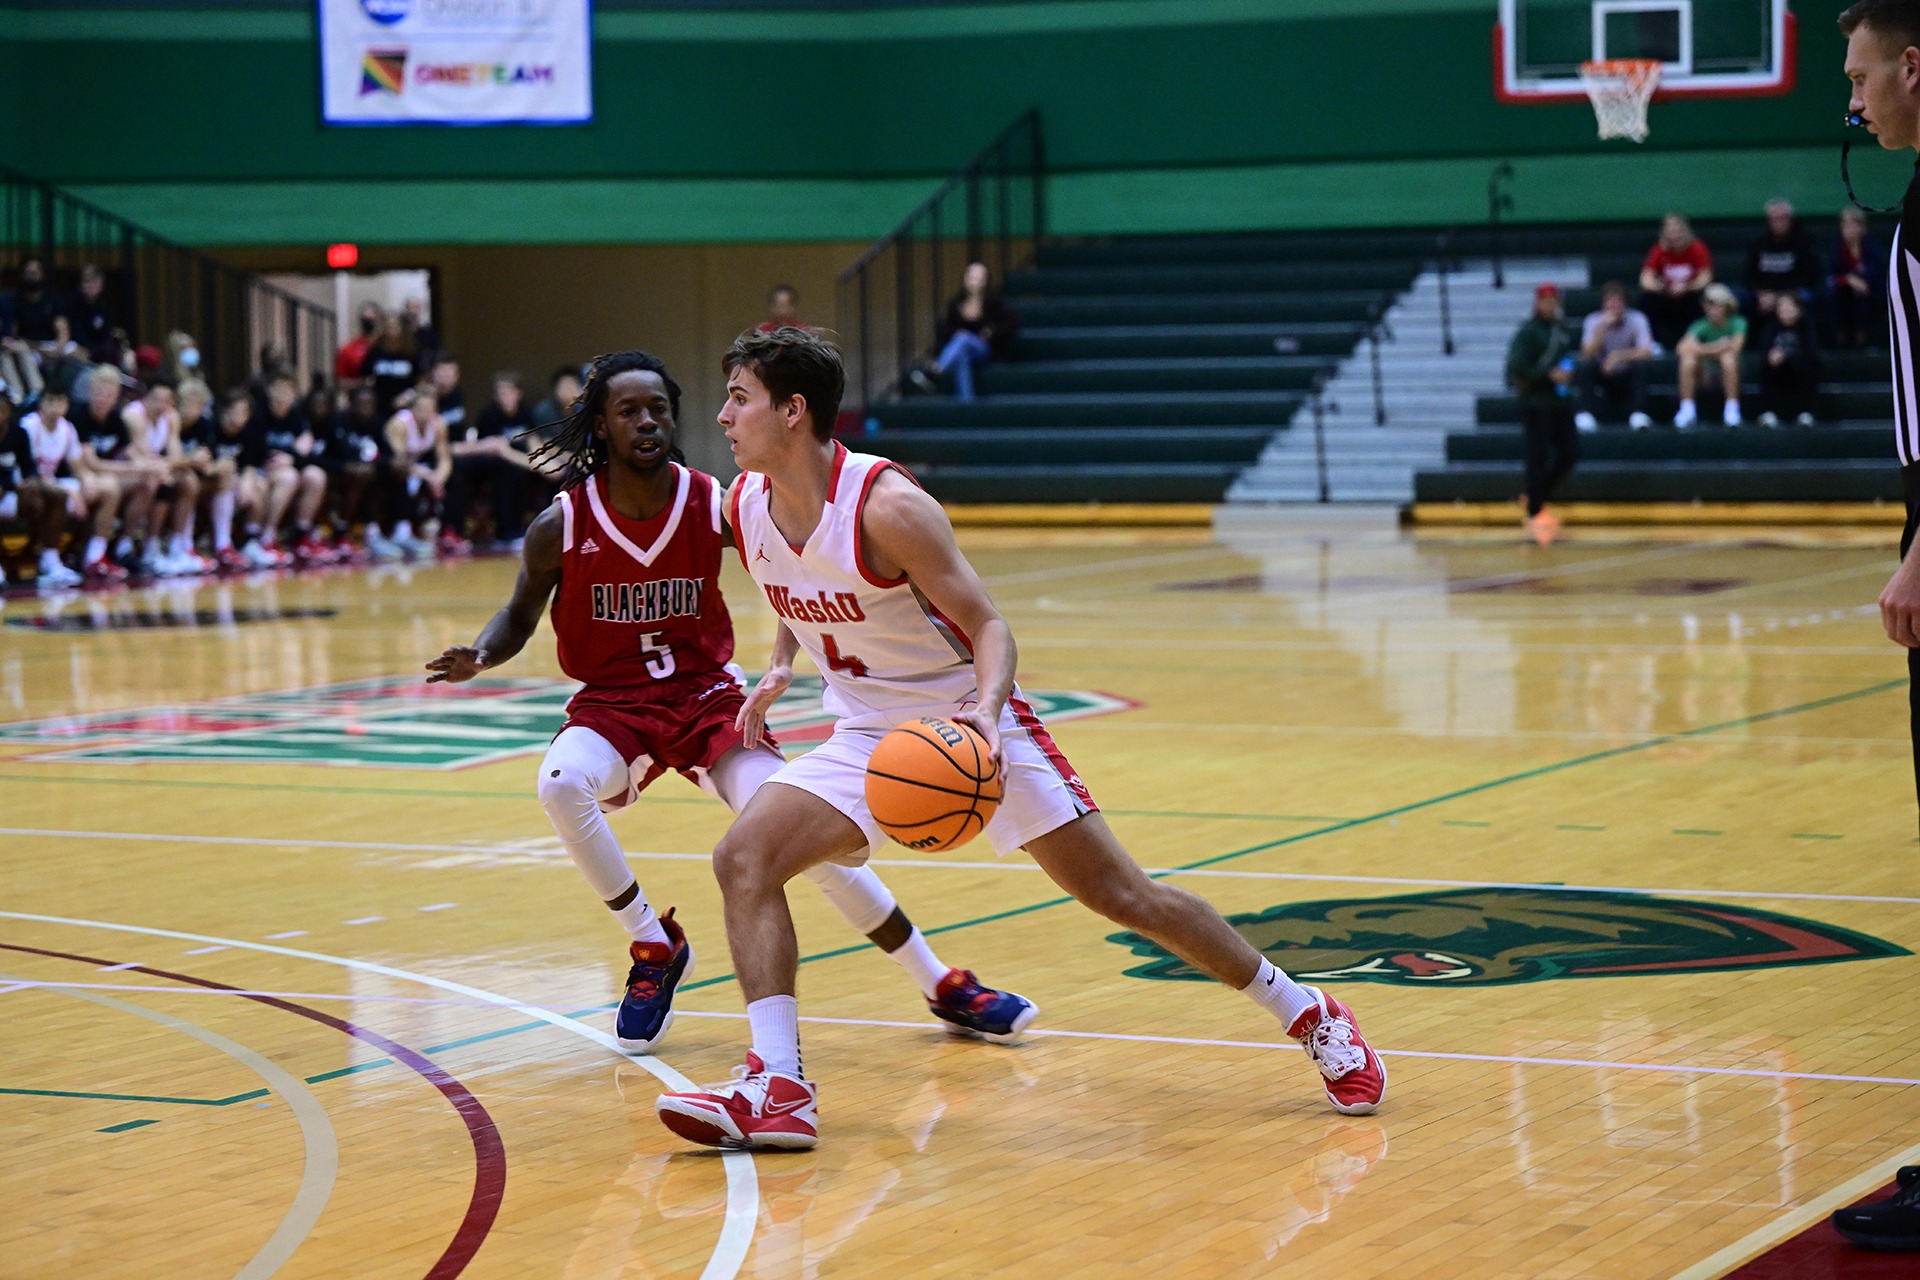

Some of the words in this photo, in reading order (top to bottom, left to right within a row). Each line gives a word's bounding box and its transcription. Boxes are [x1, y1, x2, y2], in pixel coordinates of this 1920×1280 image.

[763, 583, 866, 623] WashU
[639, 631, 676, 679] 5
[820, 632, 869, 679] 4
